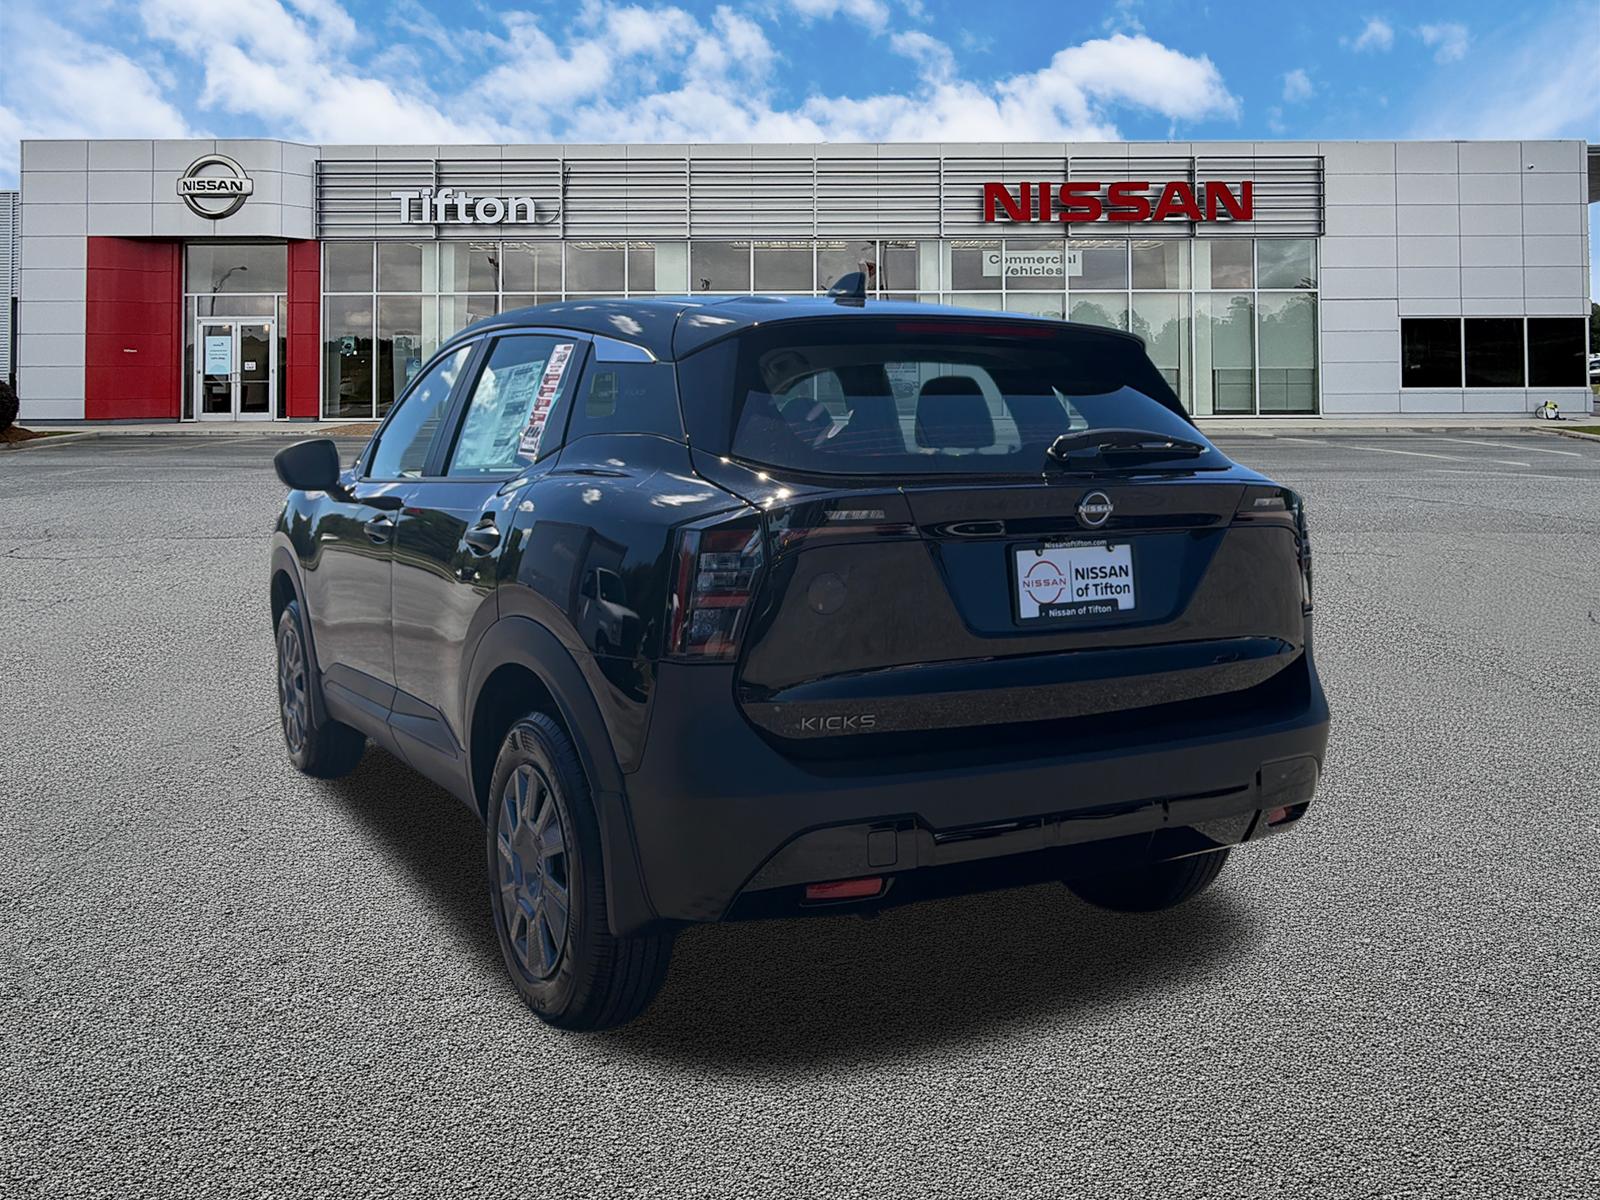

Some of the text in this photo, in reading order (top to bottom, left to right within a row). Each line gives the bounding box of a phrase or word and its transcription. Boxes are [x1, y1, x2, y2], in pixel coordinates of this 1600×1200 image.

[183, 180, 243, 191] NISSAN
[391, 188, 536, 224] Tifton
[983, 181, 1253, 222] NISSAN
[1078, 503, 1114, 512] NISSAN
[1075, 564, 1129, 580] NISSAN
[1023, 578, 1067, 588] NISSAN
[1076, 583, 1130, 598] of Tifton
[1049, 605, 1112, 617] Nissan of Tifton
[800, 714, 876, 731] KICKS
